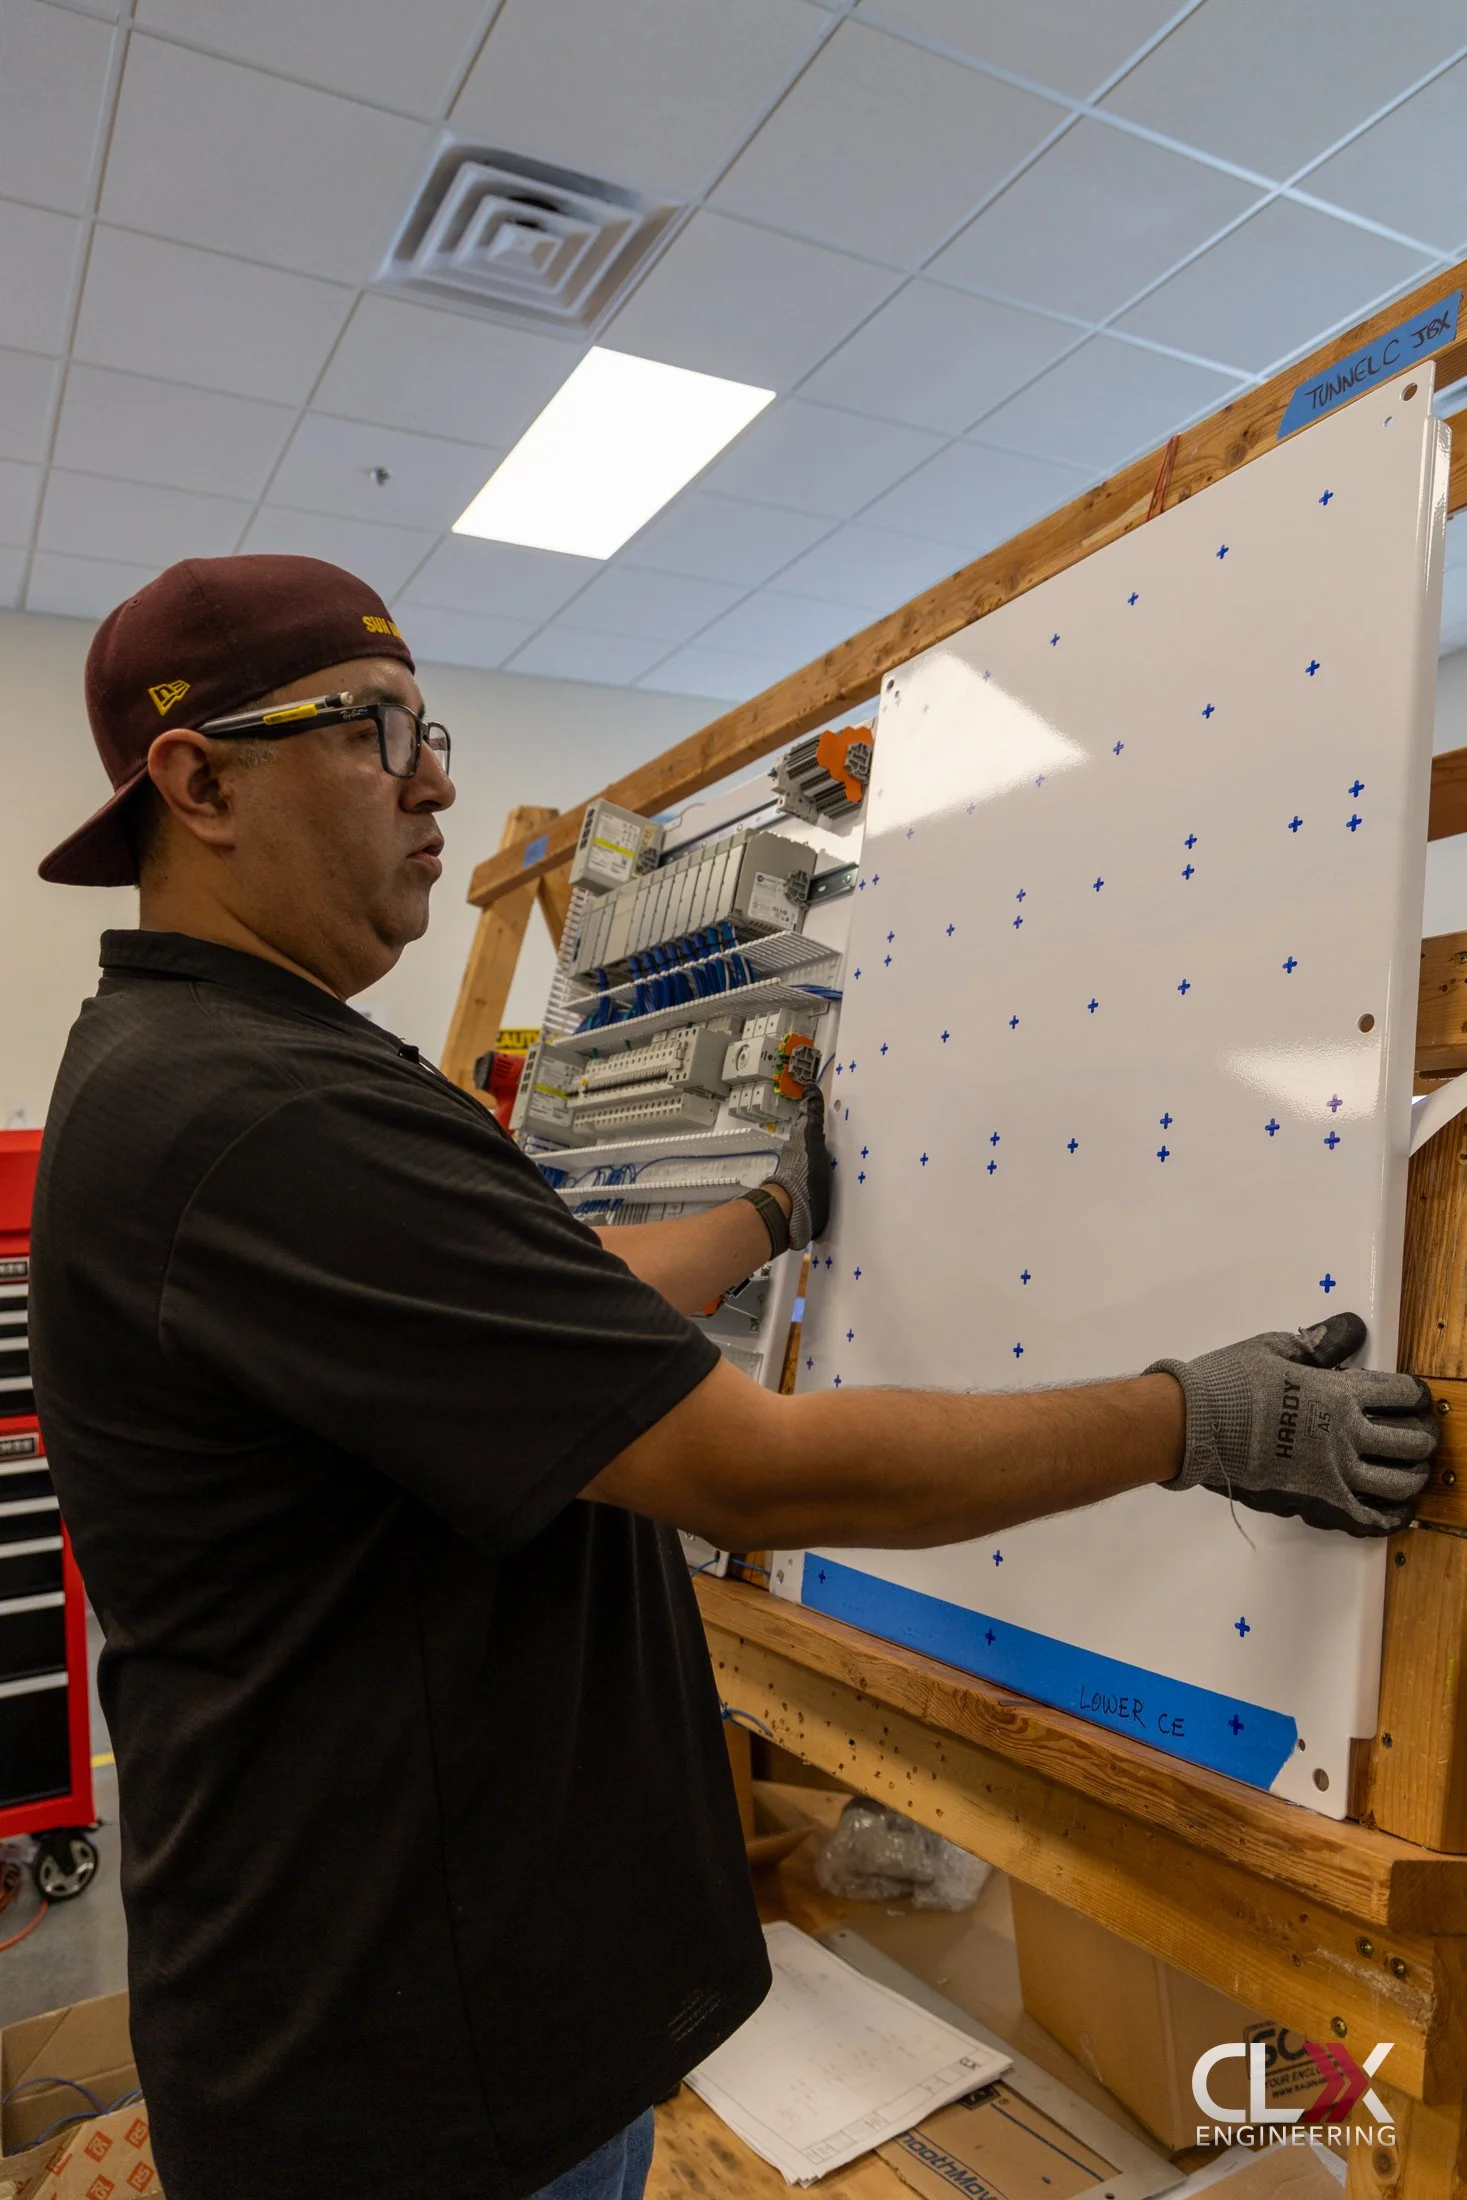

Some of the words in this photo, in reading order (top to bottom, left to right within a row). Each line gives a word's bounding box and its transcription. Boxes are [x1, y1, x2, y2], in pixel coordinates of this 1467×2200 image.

[1304, 356, 1382, 410] TUNNEL
[1382, 339, 1401, 366] C
[362, 615, 391, 635] SUN
[1276, 1379, 1300, 1458] HARDY
[1318, 1411, 1331, 1433] A5
[1079, 1686, 1146, 1728] LOWER
[1158, 1713, 1186, 1737] CE
